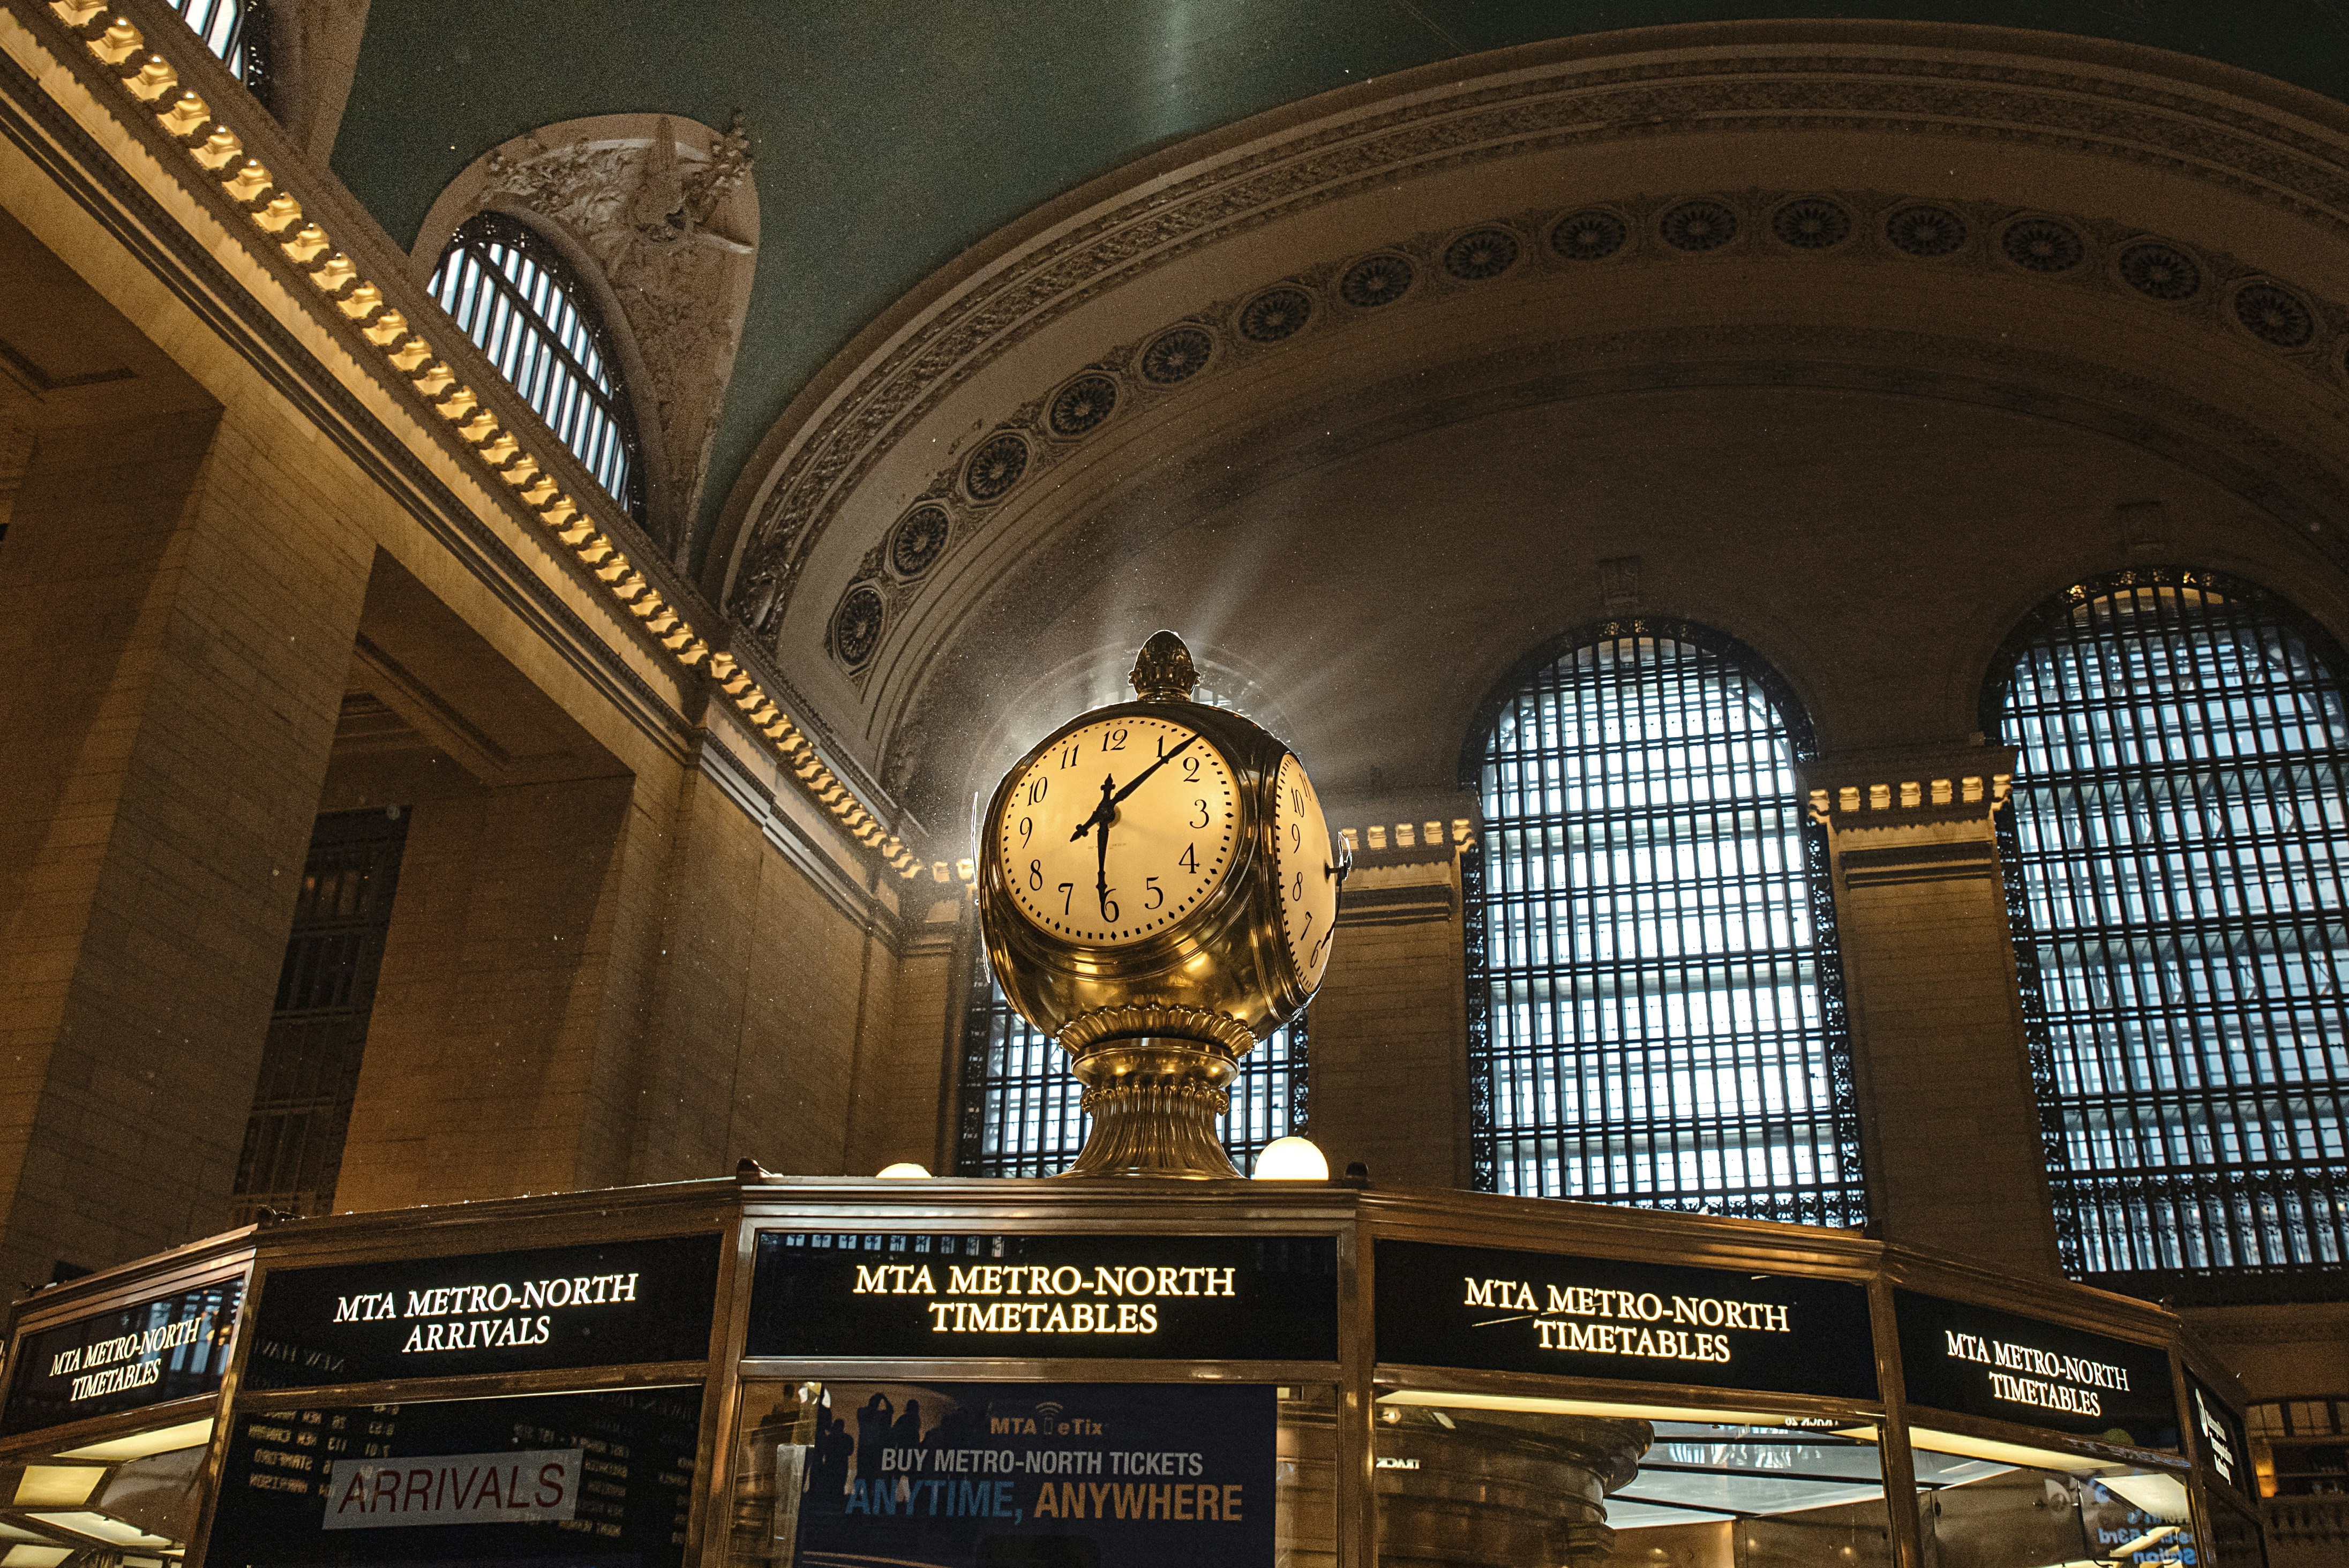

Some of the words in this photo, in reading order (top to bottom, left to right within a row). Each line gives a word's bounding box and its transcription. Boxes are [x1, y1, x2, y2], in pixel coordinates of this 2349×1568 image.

[1101, 729, 1128, 752] 12
[1157, 736, 1164, 758] 1
[1060, 744, 1079, 770] 11
[1183, 757, 1200, 783] 2
[1027, 777, 1048, 806] 10
[1291, 786, 1304, 818] 10
[1299, 772, 1312, 802] 11
[1189, 799, 1209, 829] 3
[1019, 817, 1033, 849] 9
[1292, 823, 1300, 854] 9
[1178, 842, 1200, 874] 4
[1029, 859, 1043, 891] 8
[1292, 872, 1303, 902] 8
[1058, 883, 1074, 916] 7
[1100, 888, 1120, 923] 6
[1144, 876, 1164, 910] 5
[1300, 911, 1313, 941] 7
[1310, 940, 1322, 969] 6
[853, 1265, 936, 1294] MTA
[947, 1265, 1235, 1296] METRO-NORTH
[333, 1292, 396, 1323] MTA
[403, 1273, 639, 1317] METRO-NORTH
[1464, 1277, 1539, 1310] MTA
[1547, 1284, 1790, 1332] METRO-NORTH
[402, 1315, 550, 1353] ARRIVALS
[928, 1302, 1158, 1334] TIMETABLES
[49, 1347, 81, 1377] MTA
[82, 1317, 202, 1369] METRO-NORTH
[1533, 1319, 1731, 1363] TIMETABLES
[1945, 1330, 1991, 1363] MTA
[1992, 1340, 2130, 1392] METRO-NORTH
[70, 1358, 161, 1402] TIMETABLES
[1988, 1371, 2101, 1417] TIMETABLES
[990, 1417, 1037, 1435] MTA
[1057, 1419, 1102, 1435] eTix
[881, 1448, 928, 1472] BUY
[935, 1449, 1102, 1474] METRO-NORTH
[1109, 1451, 1203, 1476] TICKETS
[338, 1463, 565, 1513] ARRIVALS
[845, 1479, 1023, 1525] ANYTIME,
[1034, 1482, 1243, 1521] ANYWHERE
